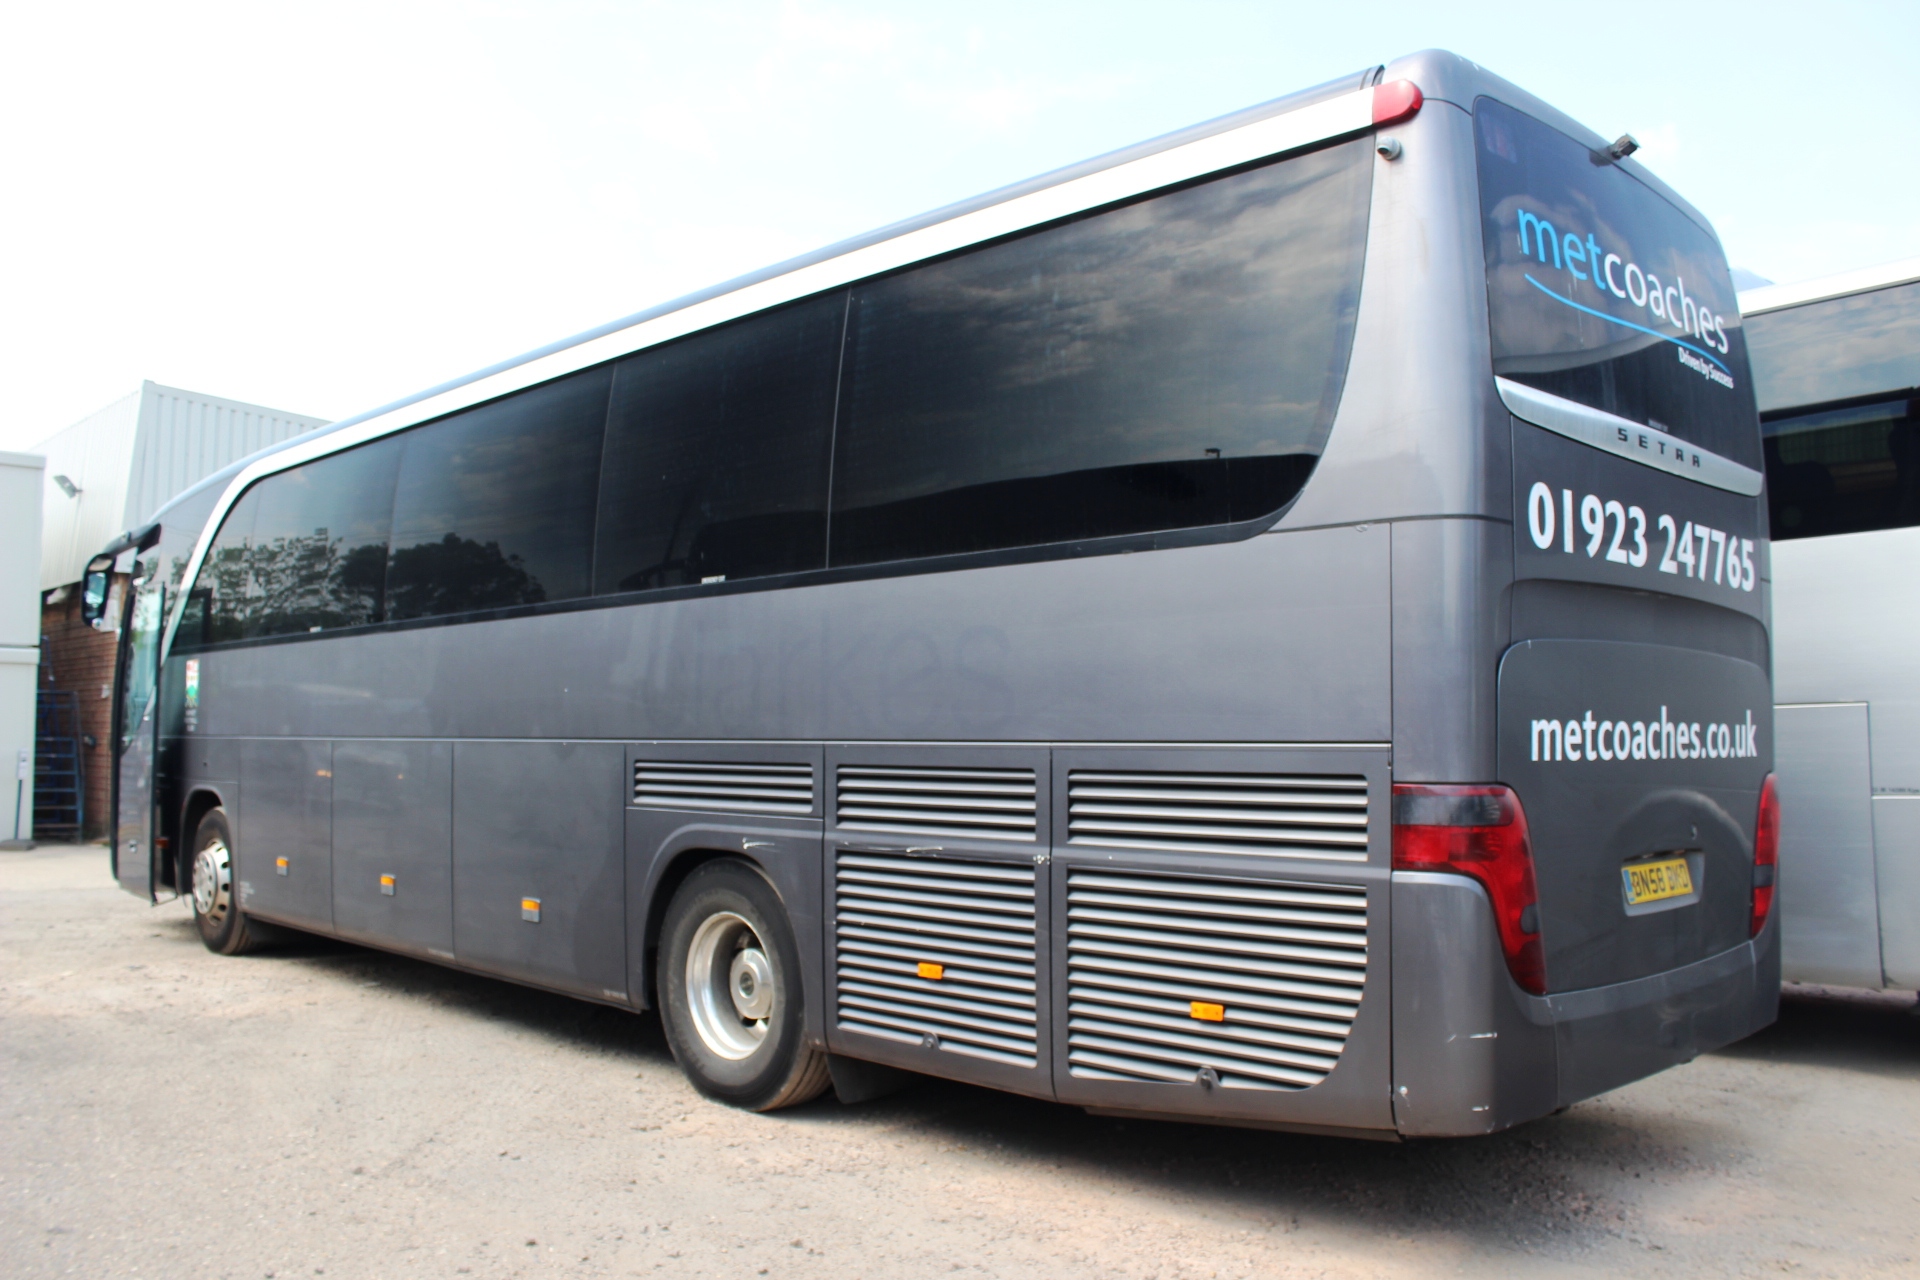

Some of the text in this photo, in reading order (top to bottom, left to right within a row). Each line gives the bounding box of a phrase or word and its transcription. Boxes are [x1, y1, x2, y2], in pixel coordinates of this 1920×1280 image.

[1517, 208, 1729, 355] metcoaches
[1617, 427, 1701, 468] SETRA
[1528, 481, 1755, 592] 01923 247765
[1531, 705, 1758, 762] metcoaches.co.uk
